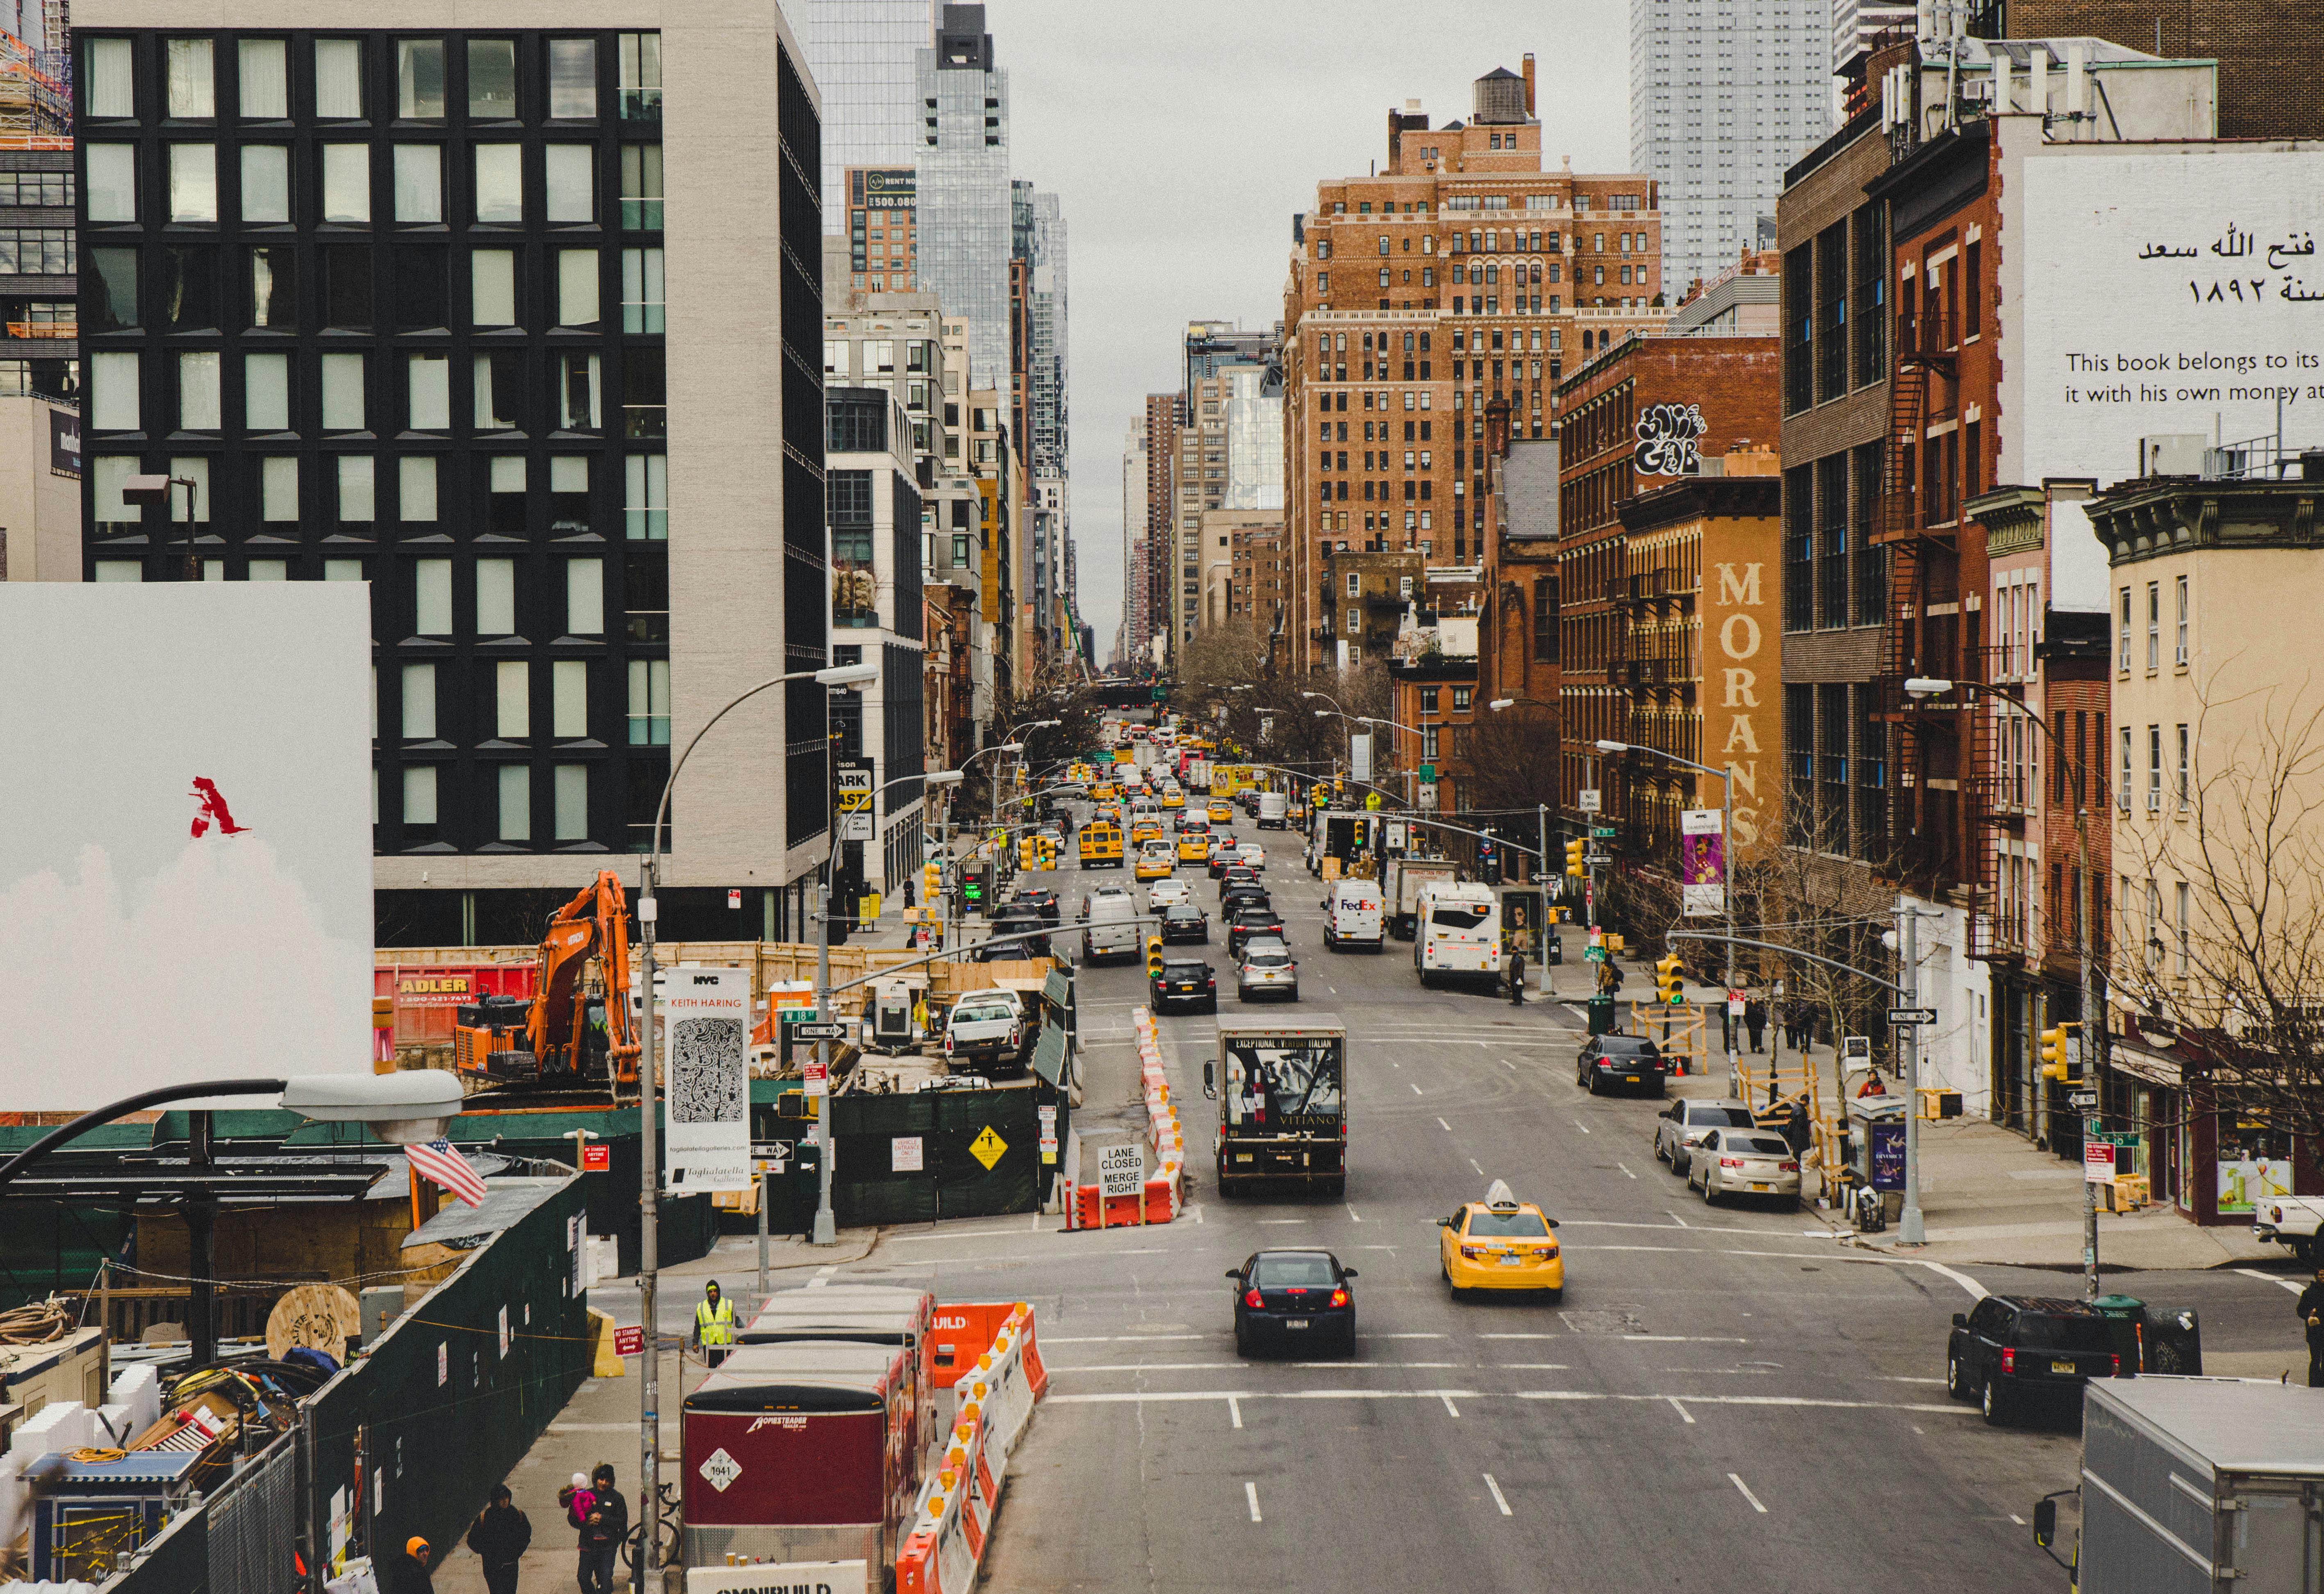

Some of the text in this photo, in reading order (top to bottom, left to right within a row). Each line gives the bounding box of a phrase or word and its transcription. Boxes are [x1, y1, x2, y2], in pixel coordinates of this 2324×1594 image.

[2139, 242, 2197, 259] سعد
[2268, 232, 2315, 270] فتح
[2066, 351, 2319, 374] This book belongs to its
[2066, 384, 2324, 405] it with his own money at
[1341, 899, 1376, 911] FedEx
[568, 931, 584, 946] HITACHI
[400, 979, 468, 993] ADLER
[694, 976, 719, 985] NYC
[671, 999, 741, 1008] KEITH HARING
[786, 1012, 793, 1021] W
[798, 1011, 806, 1021] 18
[1236, 1039, 1332, 1048] EXCEPTIONAL EVERYDAY ITALIAN
[1280, 1115, 1336, 1125] VITIANO
[1108, 1148, 1134, 1158] LANE
[1102, 1158, 1142, 1169] CLOSED
[689, 1167, 744, 1177] Taglialatella
[1104, 1172, 1139, 1183] MERGE
[1107, 1183, 1137, 1193] RIGHT
[622, 1328, 641, 1336] STANDING
[746, 1416, 807, 1434] HOMESTEADER
